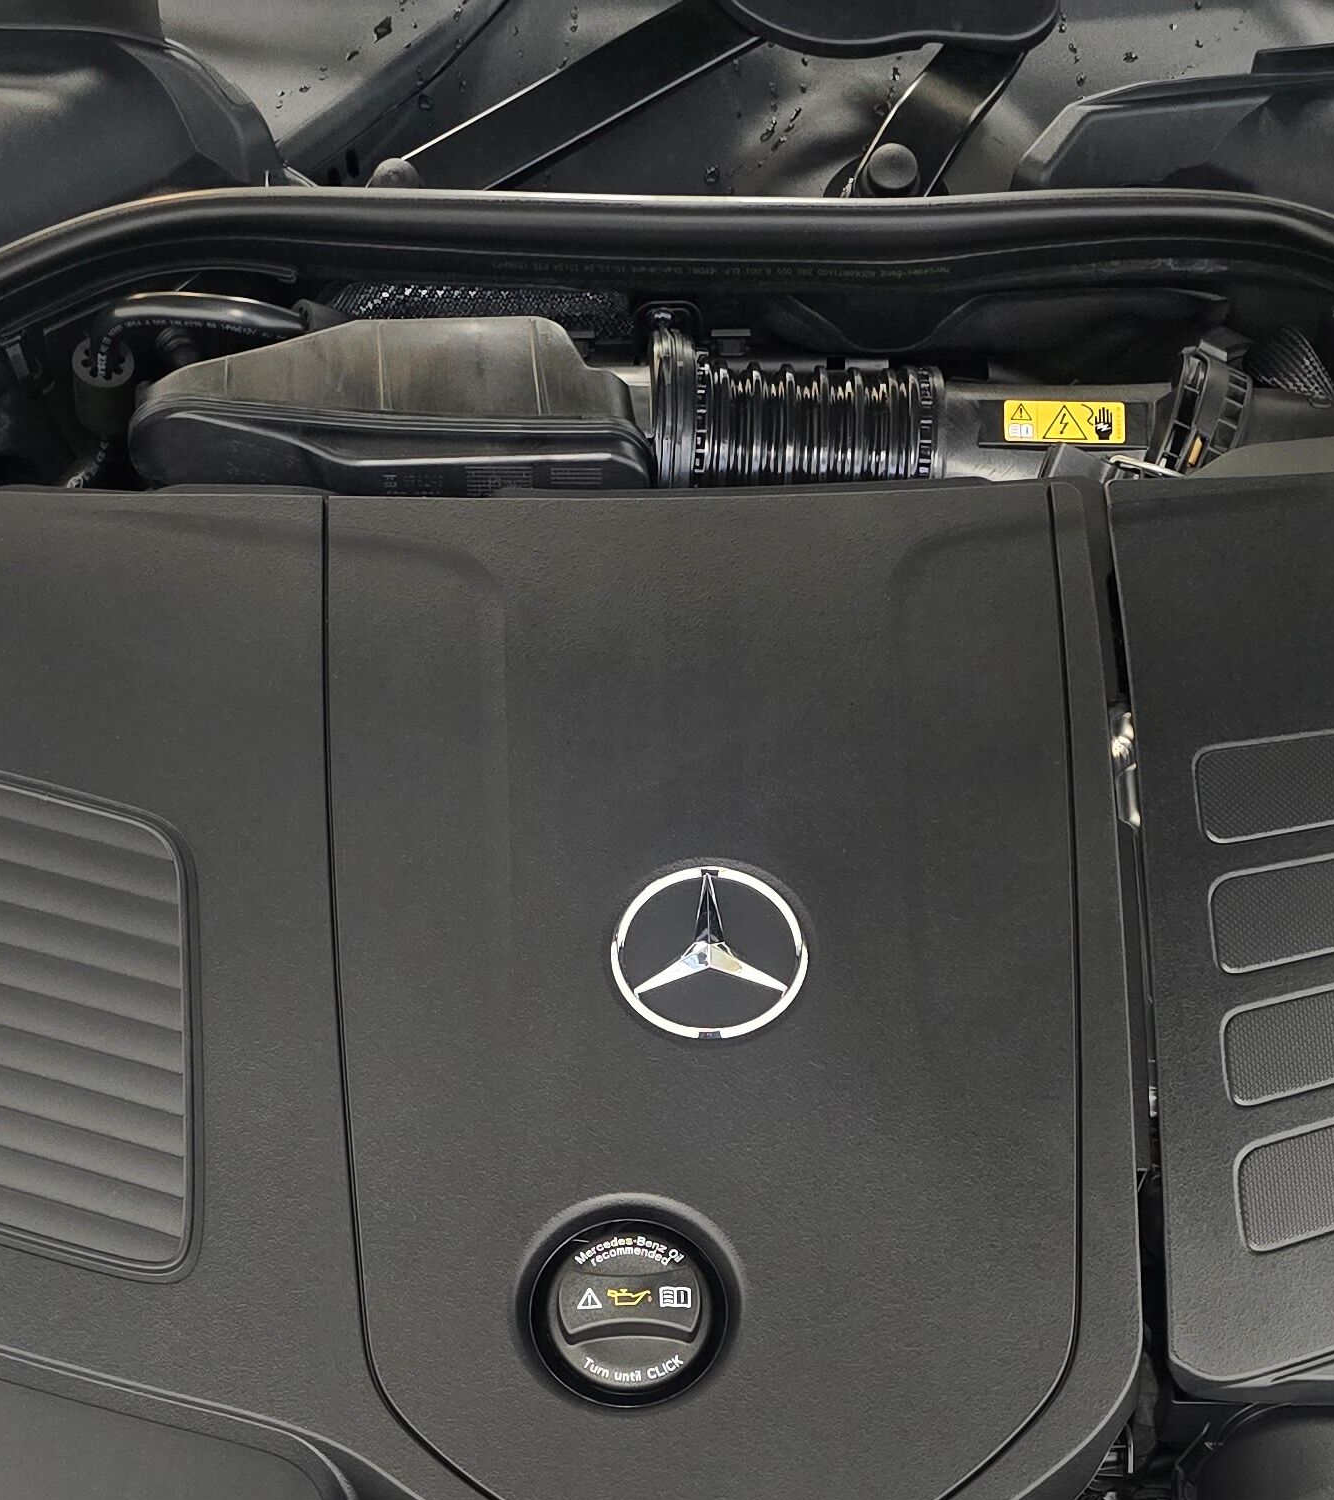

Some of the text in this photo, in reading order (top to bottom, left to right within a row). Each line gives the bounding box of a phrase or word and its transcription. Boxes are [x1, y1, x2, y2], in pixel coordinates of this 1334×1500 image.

[574, 1235, 685, 1266] Mercedes-Benz Oil
[590, 1246, 671, 1267] recommended
[582, 1355, 685, 1382] Turn until CLICK
